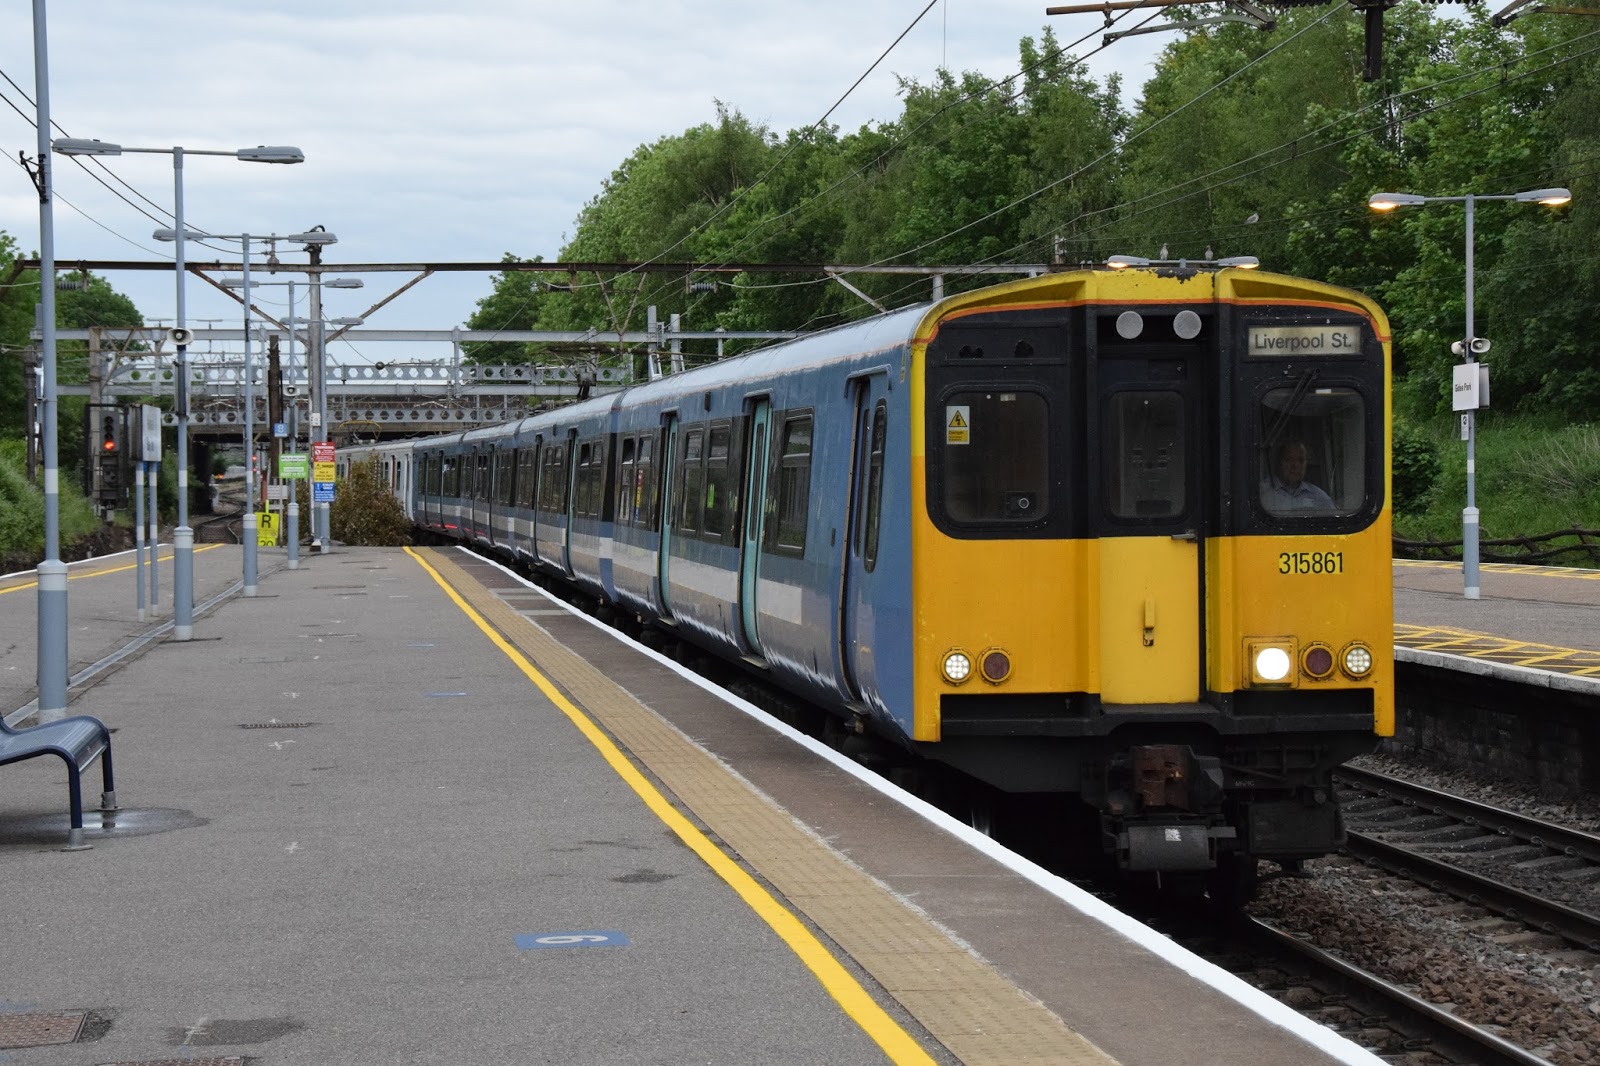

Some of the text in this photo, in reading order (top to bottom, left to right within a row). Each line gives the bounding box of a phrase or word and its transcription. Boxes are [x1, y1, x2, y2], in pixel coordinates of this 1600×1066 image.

[1254, 332, 1352, 352] Liverpool St.
[278, 423, 284, 433] 8
[261, 514, 272, 529] R
[1279, 552, 1343, 574] 315861
